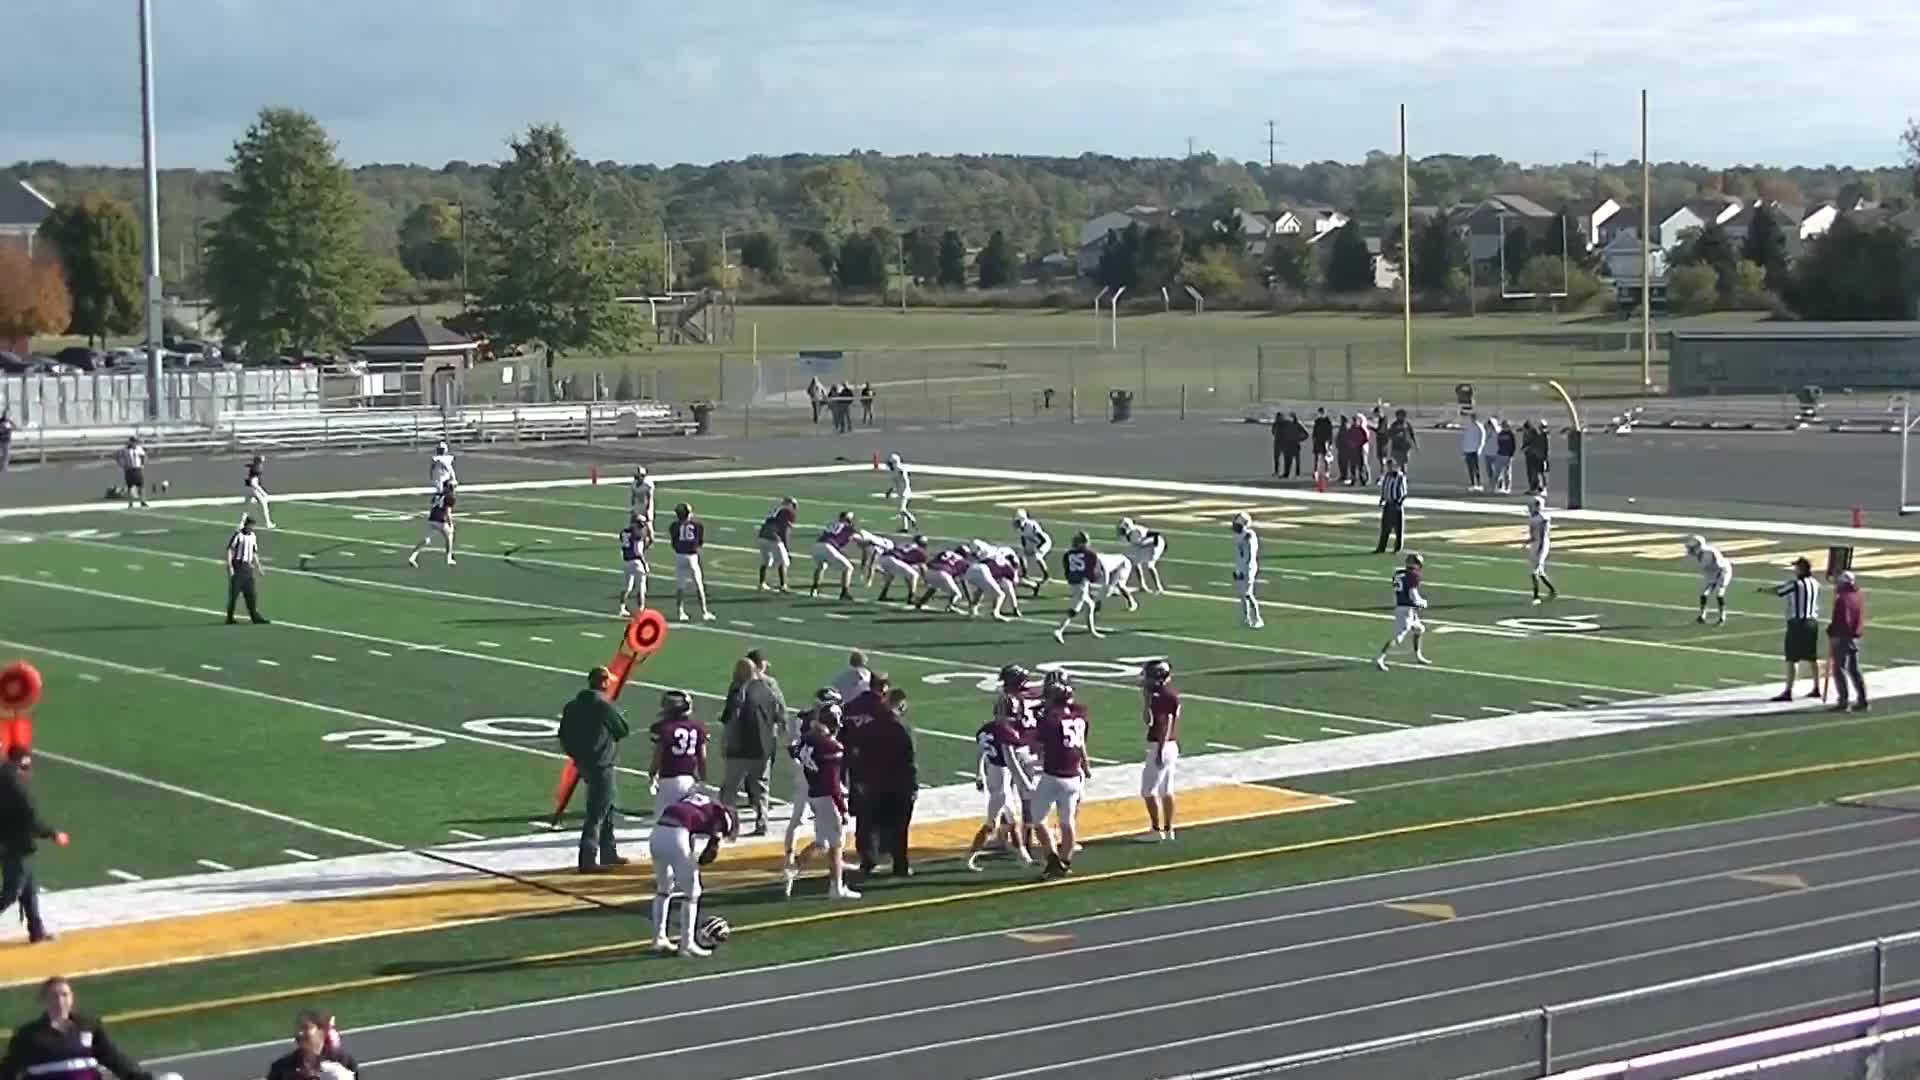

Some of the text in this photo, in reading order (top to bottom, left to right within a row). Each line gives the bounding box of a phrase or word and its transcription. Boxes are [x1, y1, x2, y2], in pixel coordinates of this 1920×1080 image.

[680, 524, 695, 541] 16
[321, 716, 562, 751] 30
[672, 727, 698, 756] 31
